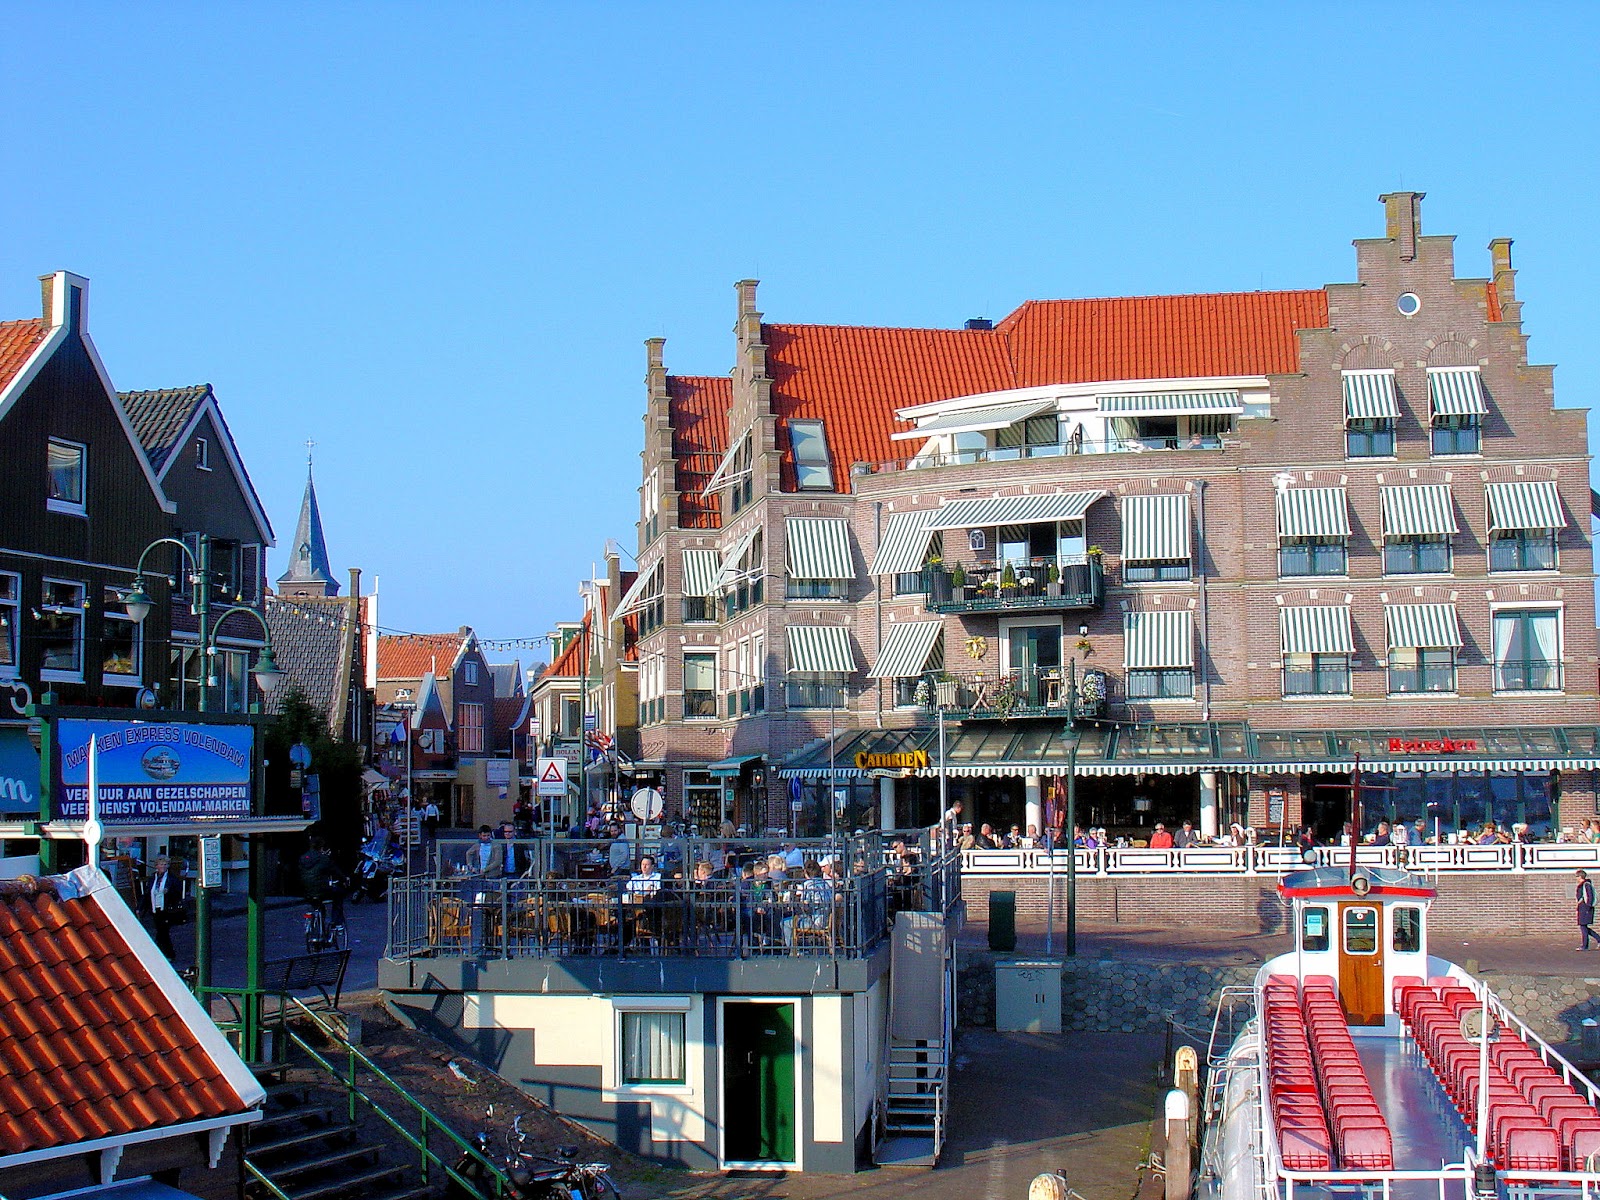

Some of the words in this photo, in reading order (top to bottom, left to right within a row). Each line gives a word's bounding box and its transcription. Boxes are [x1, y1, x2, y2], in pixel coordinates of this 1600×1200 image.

[125, 726, 180, 744] EXPRESS
[183, 729, 246, 769] VOLENDAM
[855, 750, 928, 768] CATHRIEN
[65, 788, 124, 801] VERUUR
[127, 787, 152, 800] AAN
[155, 786, 247, 800] GEZELSCHAPPEN
[140, 799, 250, 813] VOLENDAM-MARKEN
